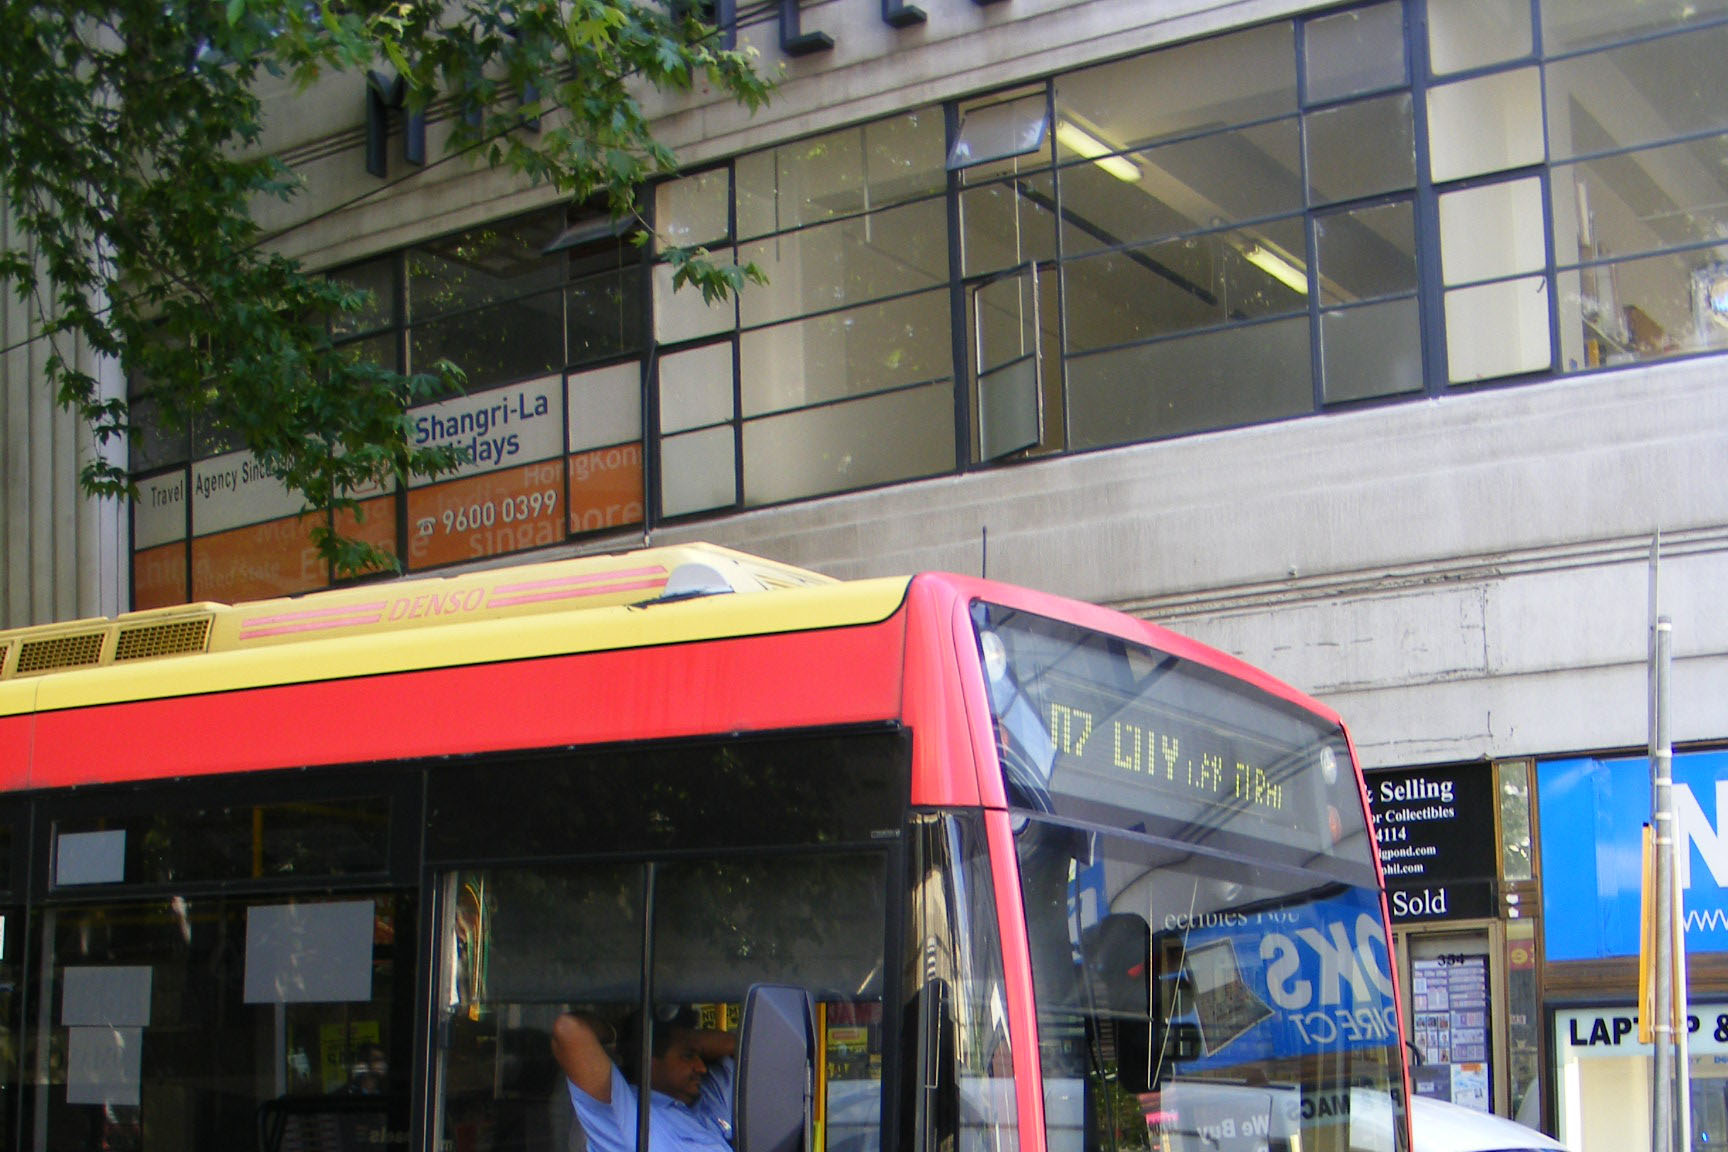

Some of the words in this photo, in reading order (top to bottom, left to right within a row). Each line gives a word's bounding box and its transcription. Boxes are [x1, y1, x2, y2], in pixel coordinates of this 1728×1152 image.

[415, 392, 549, 444] Shangri-La
[151, 480, 183, 508] Travel
[196, 470, 238, 499] Agency
[443, 508, 495, 535] 9600
[502, 489, 557, 523] 0399
[388, 587, 486, 624] DENSO
[1380, 778, 1454, 803] Selling
[1385, 806, 1455, 823] Collectibles
[1392, 888, 1447, 916] Sold
